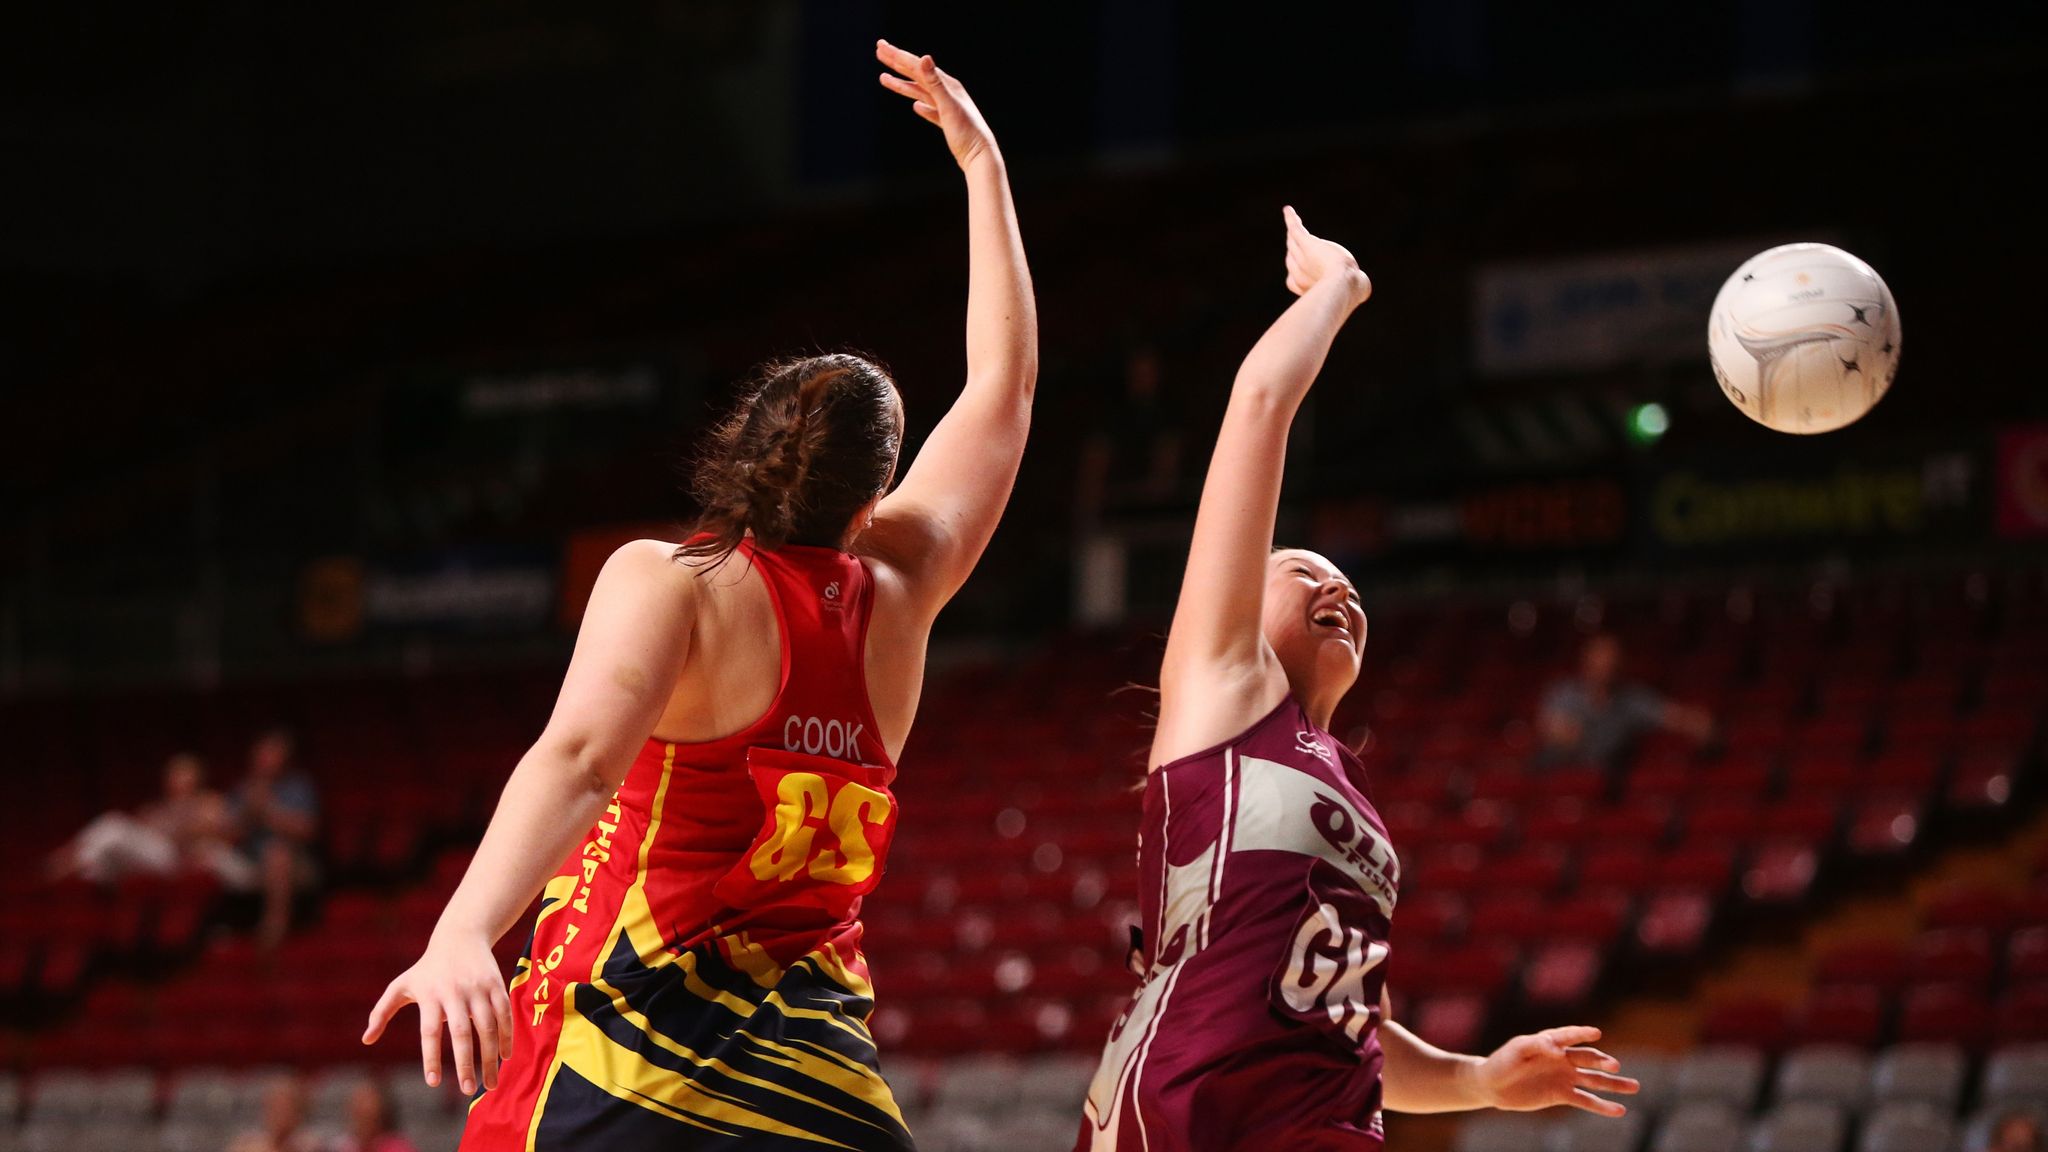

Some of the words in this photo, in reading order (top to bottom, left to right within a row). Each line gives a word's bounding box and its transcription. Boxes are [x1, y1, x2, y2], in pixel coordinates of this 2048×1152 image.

[784, 715, 863, 761] COOK
[749, 771, 891, 885] GS
[1280, 903, 1390, 1042] GK
